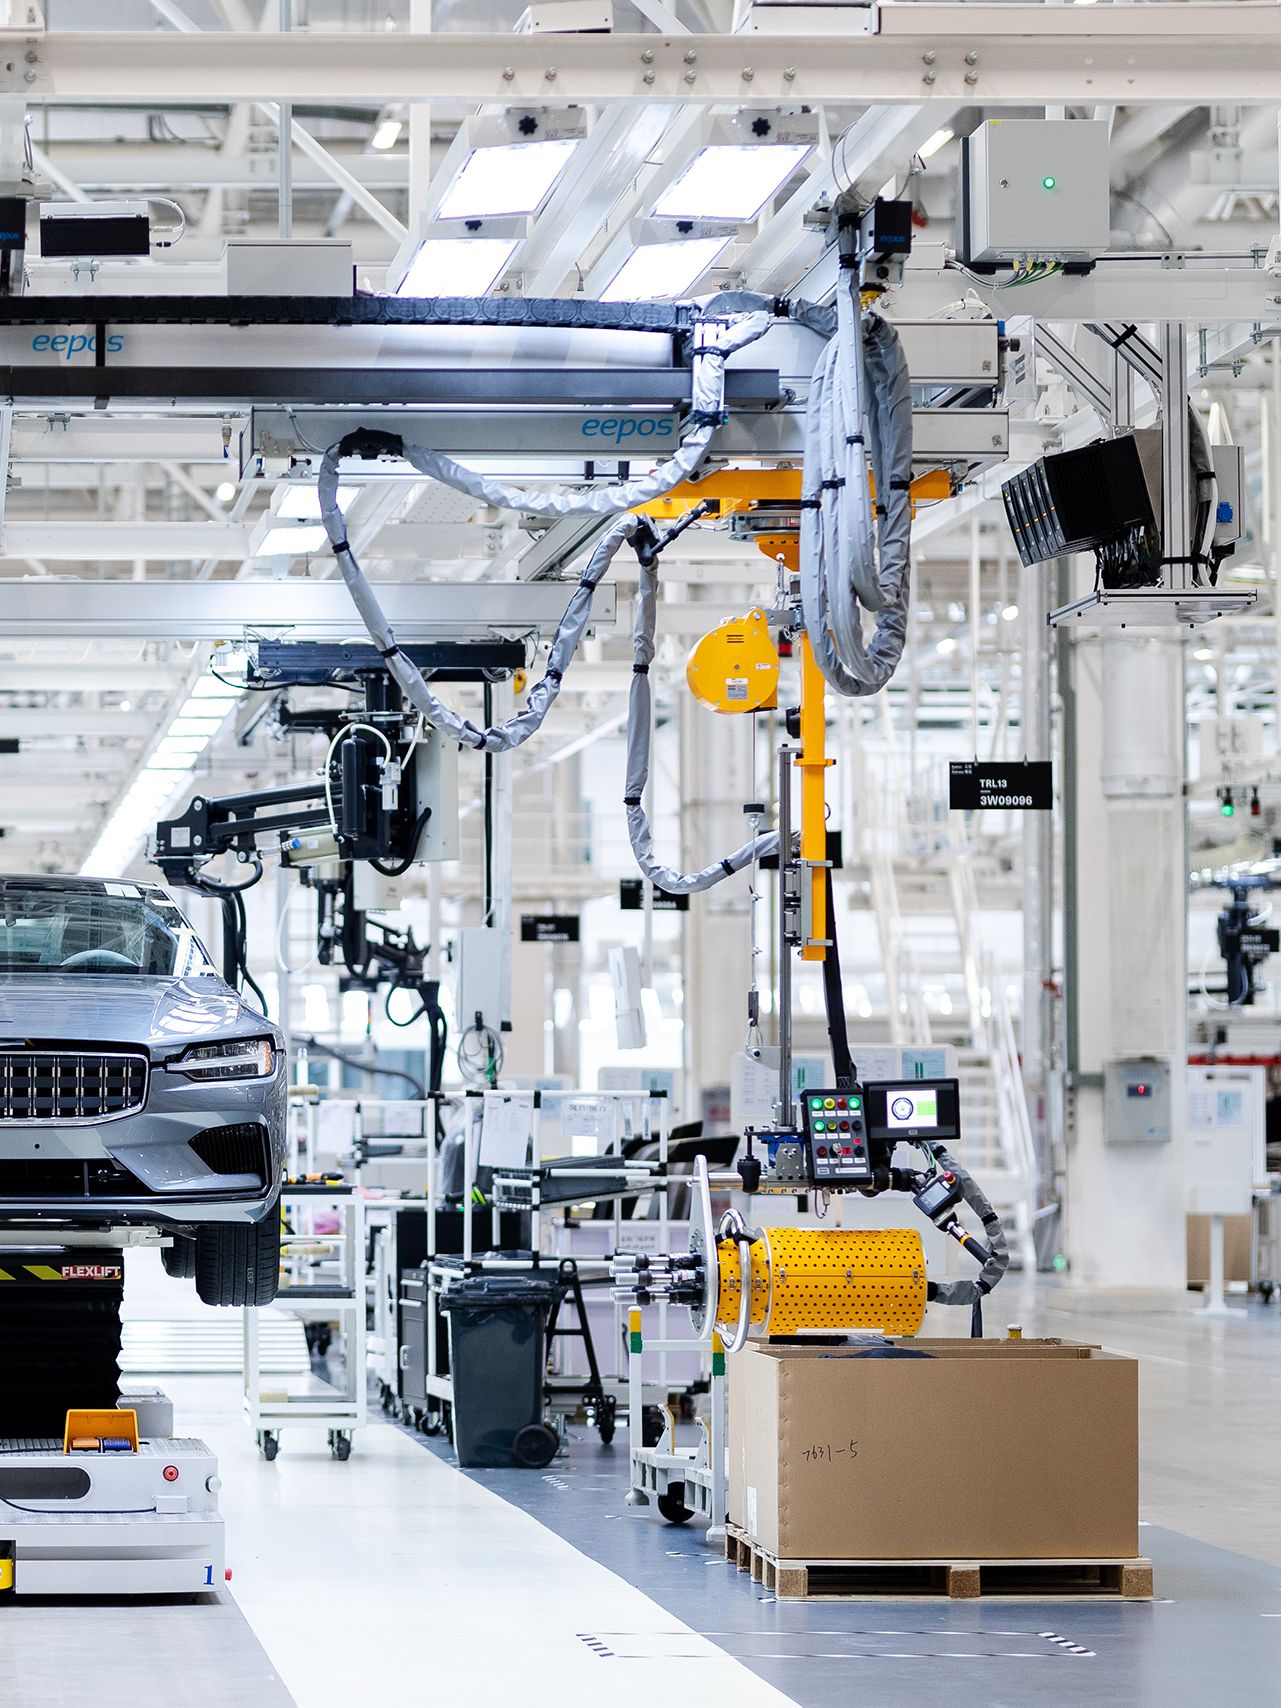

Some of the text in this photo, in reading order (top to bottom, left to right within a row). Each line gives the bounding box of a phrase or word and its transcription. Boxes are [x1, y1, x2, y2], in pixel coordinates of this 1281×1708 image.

[581, 418, 674, 444] eepos
[979, 779, 1008, 789] TRL13
[979, 795, 1033, 806] 3W09096
[61, 1266, 120, 1278] FLEXLIFT
[203, 1564, 214, 1585] 1
